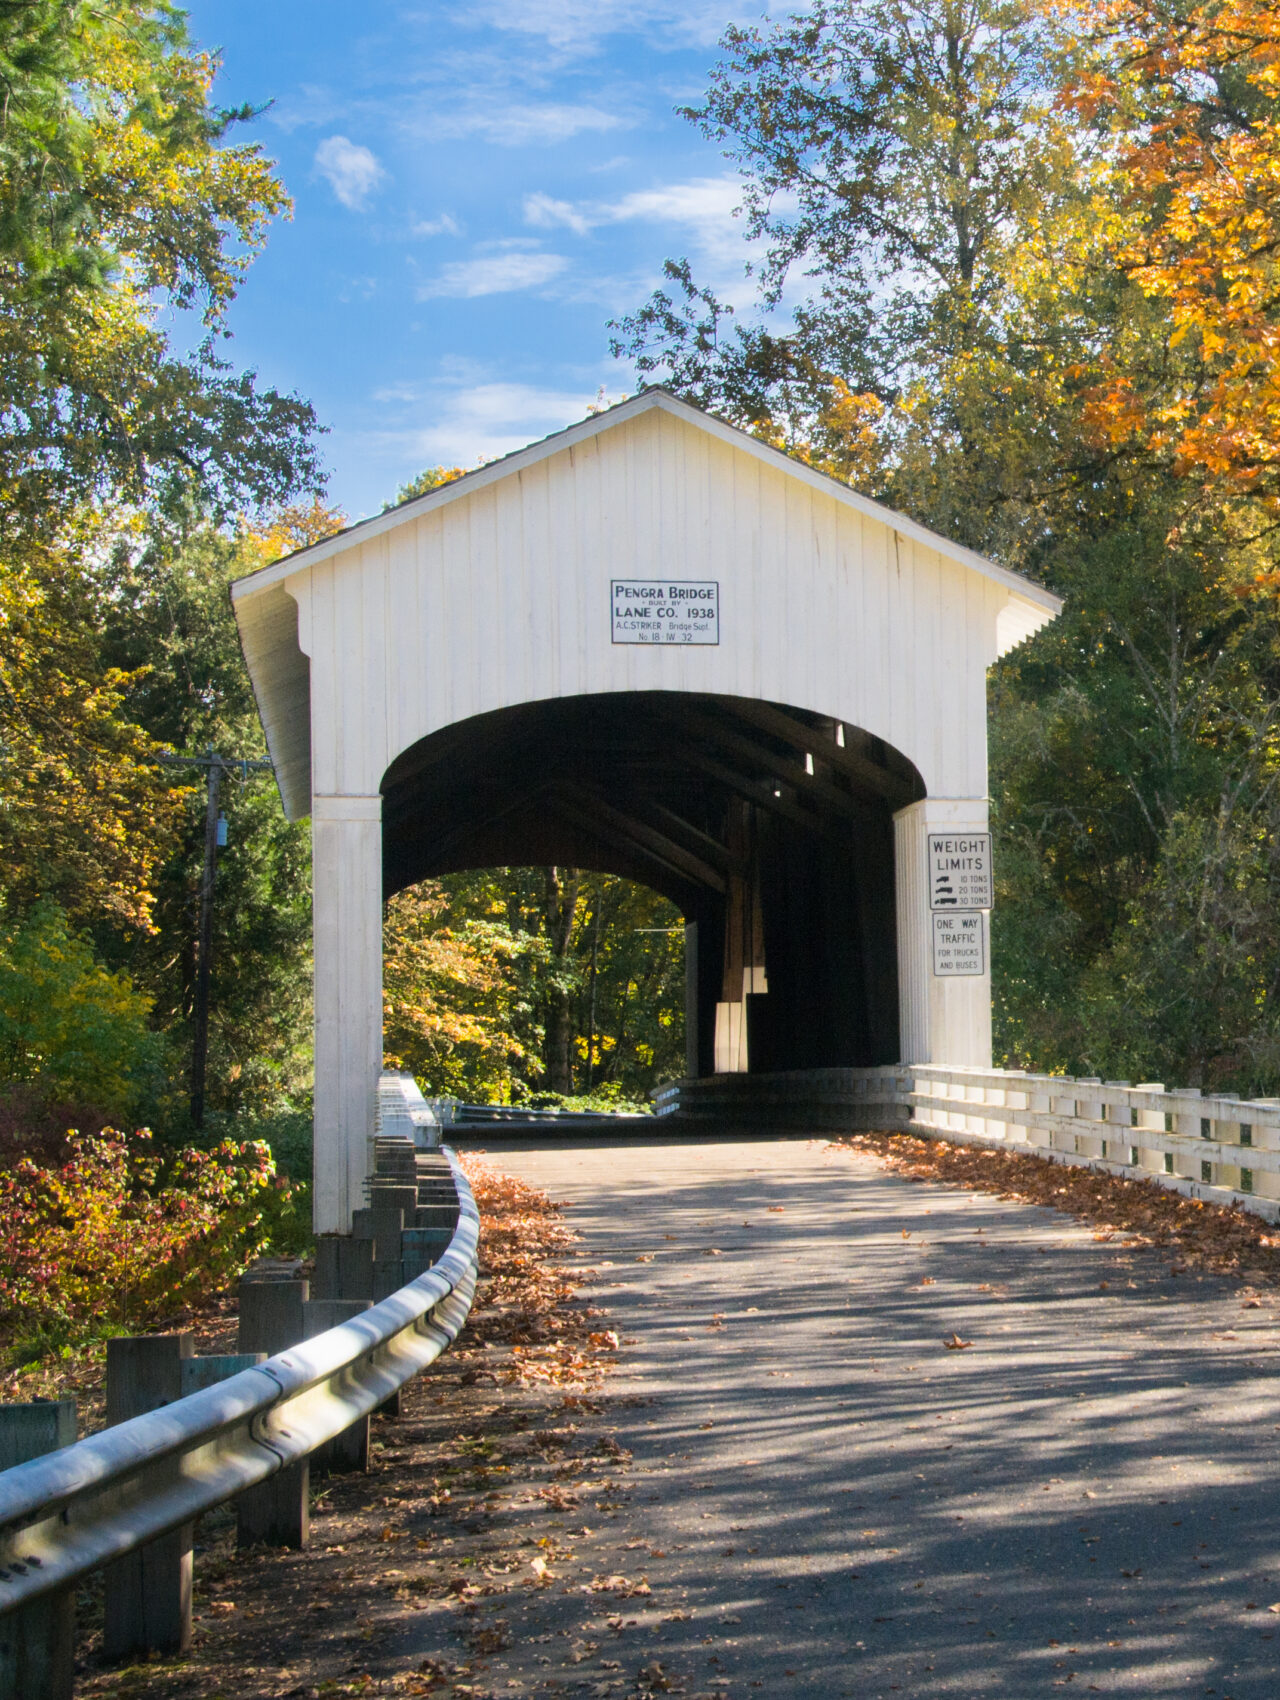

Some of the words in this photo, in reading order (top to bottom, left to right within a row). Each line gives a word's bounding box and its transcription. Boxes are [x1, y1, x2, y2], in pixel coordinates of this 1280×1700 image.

[615, 585, 664, 599] PENGRA
[669, 587, 714, 599] BRIDGE
[615, 607, 651, 618] LANE
[657, 608, 678, 619] CO.
[687, 608, 715, 619] 1938
[669, 622, 692, 631] Bridge
[652, 633, 660, 641] 18
[682, 633, 692, 641] 32
[934, 840, 986, 853] WEIGHT
[937, 858, 982, 870] LIMITS
[958, 886, 968, 894] 20
[970, 886, 988, 894] TONS
[936, 920, 954, 929] ONE
[962, 919, 978, 928] WAY
[941, 934, 975, 944] TRAFFIC
[938, 949, 950, 957] FOR
[954, 948, 978, 956] TRUCKS
[956, 961, 977, 969] BUSES
